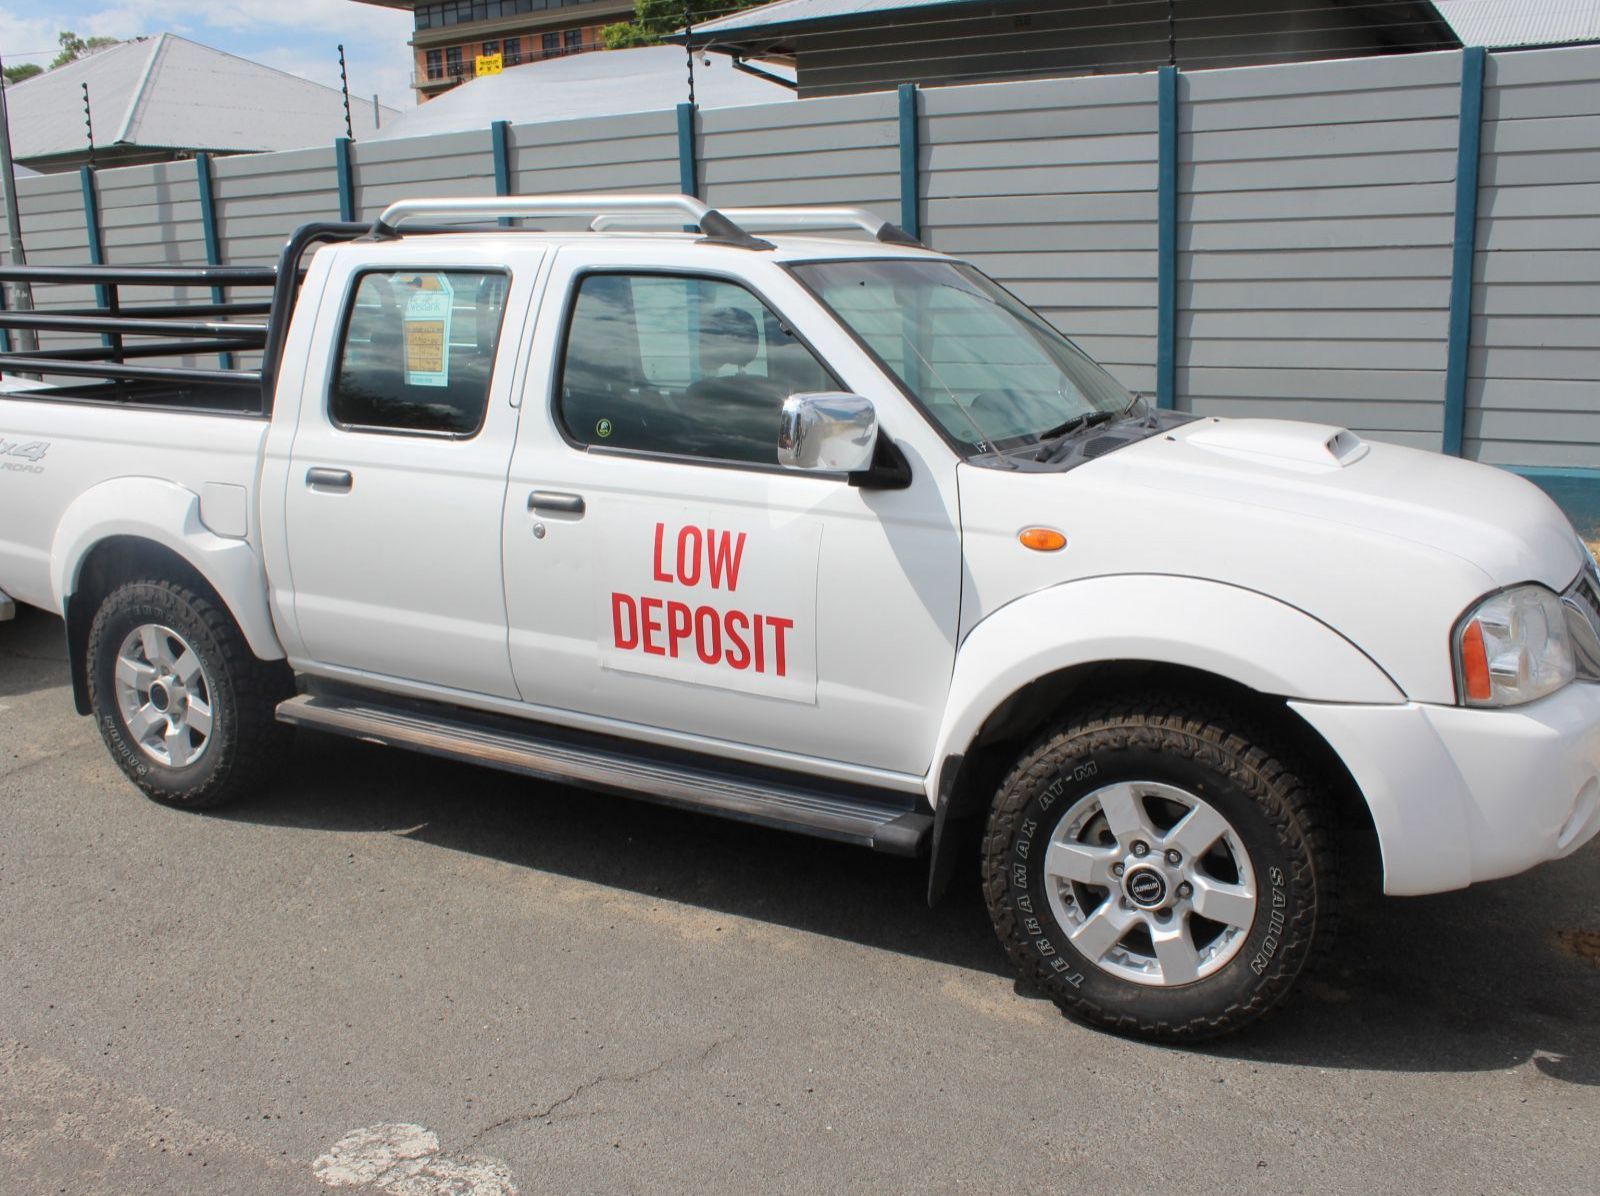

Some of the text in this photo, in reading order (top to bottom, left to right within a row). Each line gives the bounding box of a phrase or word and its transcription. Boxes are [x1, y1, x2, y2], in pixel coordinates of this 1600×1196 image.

[0, 438, 51, 462] x4
[653, 522, 748, 592] LOW
[611, 591, 794, 678] DEPOSIT
[104, 715, 148, 777] SAILUN
[1013, 760, 1098, 989] TERRAMAX AT-M
[1250, 865, 1287, 976] SAILUN
